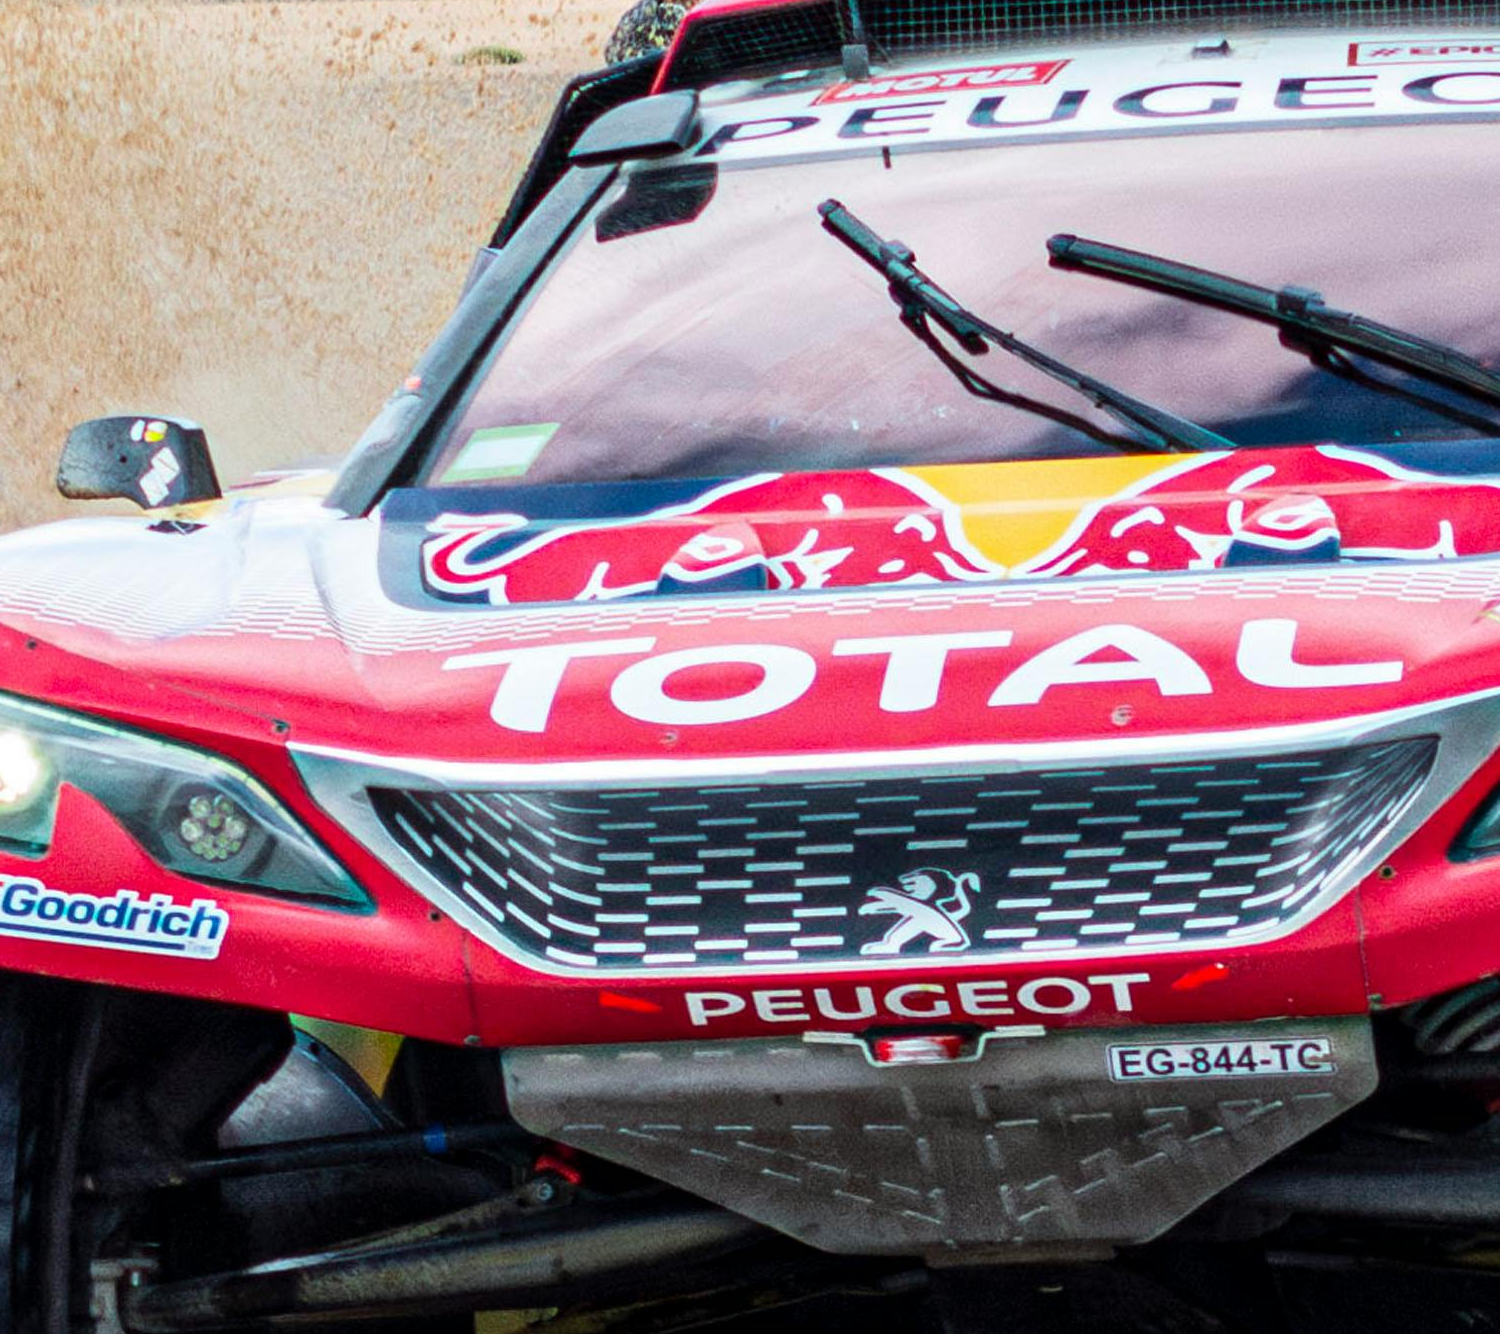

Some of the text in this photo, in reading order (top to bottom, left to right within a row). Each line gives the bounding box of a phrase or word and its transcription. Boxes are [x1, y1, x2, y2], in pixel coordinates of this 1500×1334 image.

[833, 65, 1039, 99] MOTUL
[440, 617, 1404, 733] TOTAL
[684, 972, 1151, 1026] PEUGEOT
[1118, 1043, 1326, 1079] EG-844-TC
